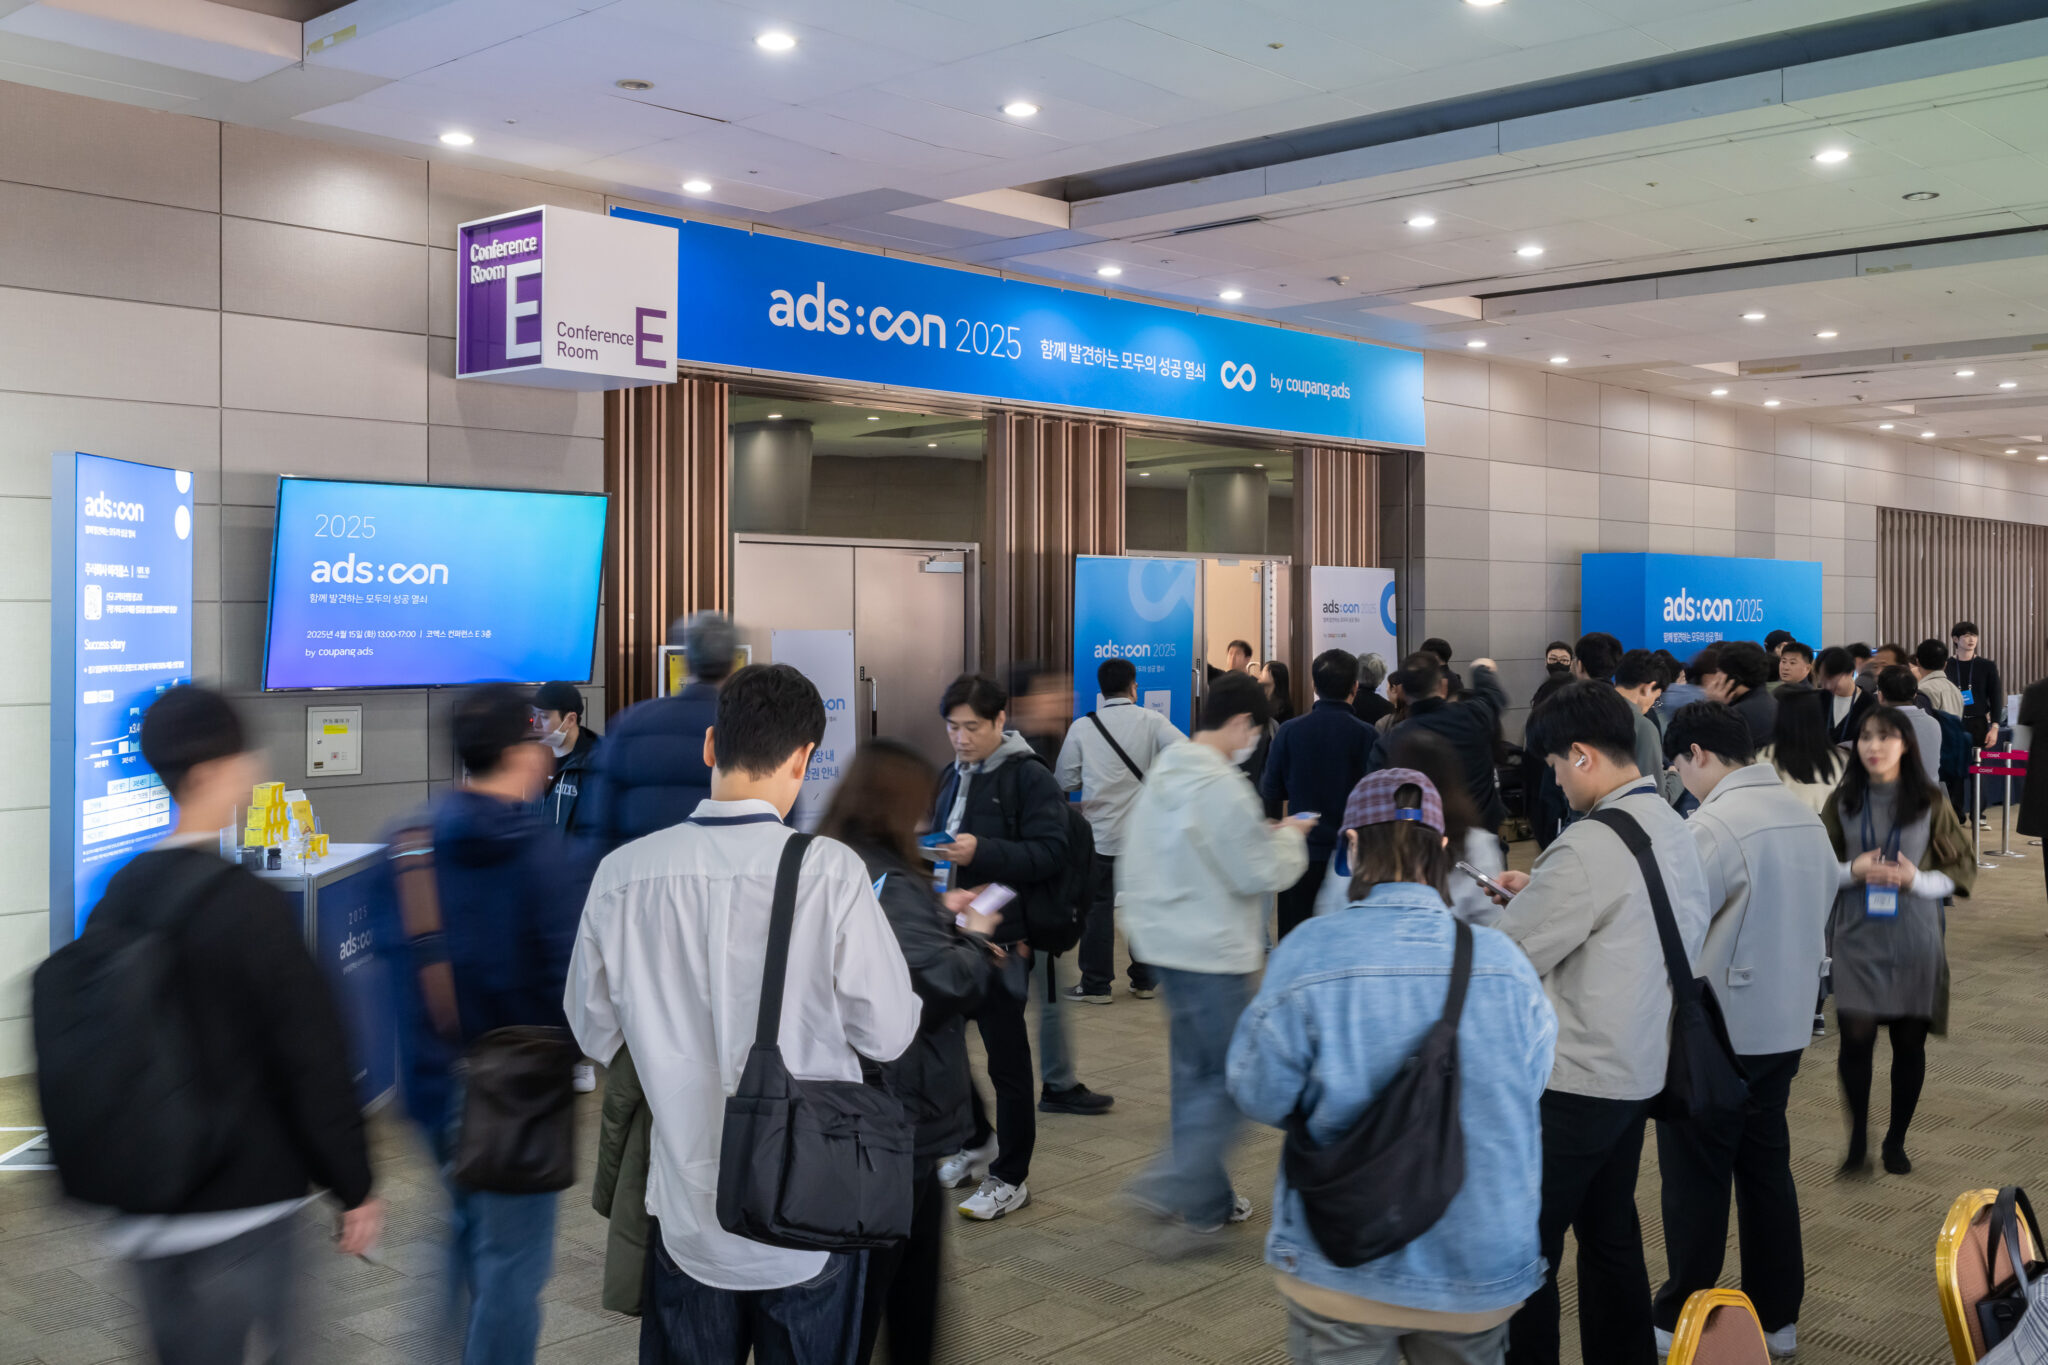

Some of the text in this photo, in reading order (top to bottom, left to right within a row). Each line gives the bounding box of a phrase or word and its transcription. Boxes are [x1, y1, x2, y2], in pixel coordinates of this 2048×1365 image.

[470, 236, 538, 263] Conference
[470, 264, 506, 285] Room
[506, 258, 542, 360] E
[768, 281, 1022, 360] ads:con 2025
[557, 321, 635, 347] Conference
[635, 306, 667, 369] E
[557, 341, 599, 361] Room
[1040, 338, 1206, 382] 함께 발견하는 모두의 성공 열쇠
[1270, 373, 1351, 401] by coupang ads
[84, 491, 145, 523] ads:con
[314, 514, 377, 539] 2025
[311, 552, 449, 585] ads:con
[309, 592, 428, 605] 함께 발견하는 모두의 성공 열쇠
[1322, 599, 1360, 614] ads:con
[1663, 587, 1764, 623] ads:con 2025
[84, 639, 126, 652] Success story
[306, 630, 333, 639] 2025년
[334, 630, 347, 639] 4월
[348, 630, 363, 639] 15일
[377, 630, 417, 639] 13:00-17:00
[426, 630, 446, 639] 코엑스
[447, 630, 474, 640] 컨퍼런스
[475, 630, 480, 639] E
[305, 646, 374, 658] by coupang ads
[1094, 639, 1177, 658] ads:con 2025
[821, 766, 839, 780] 안내
